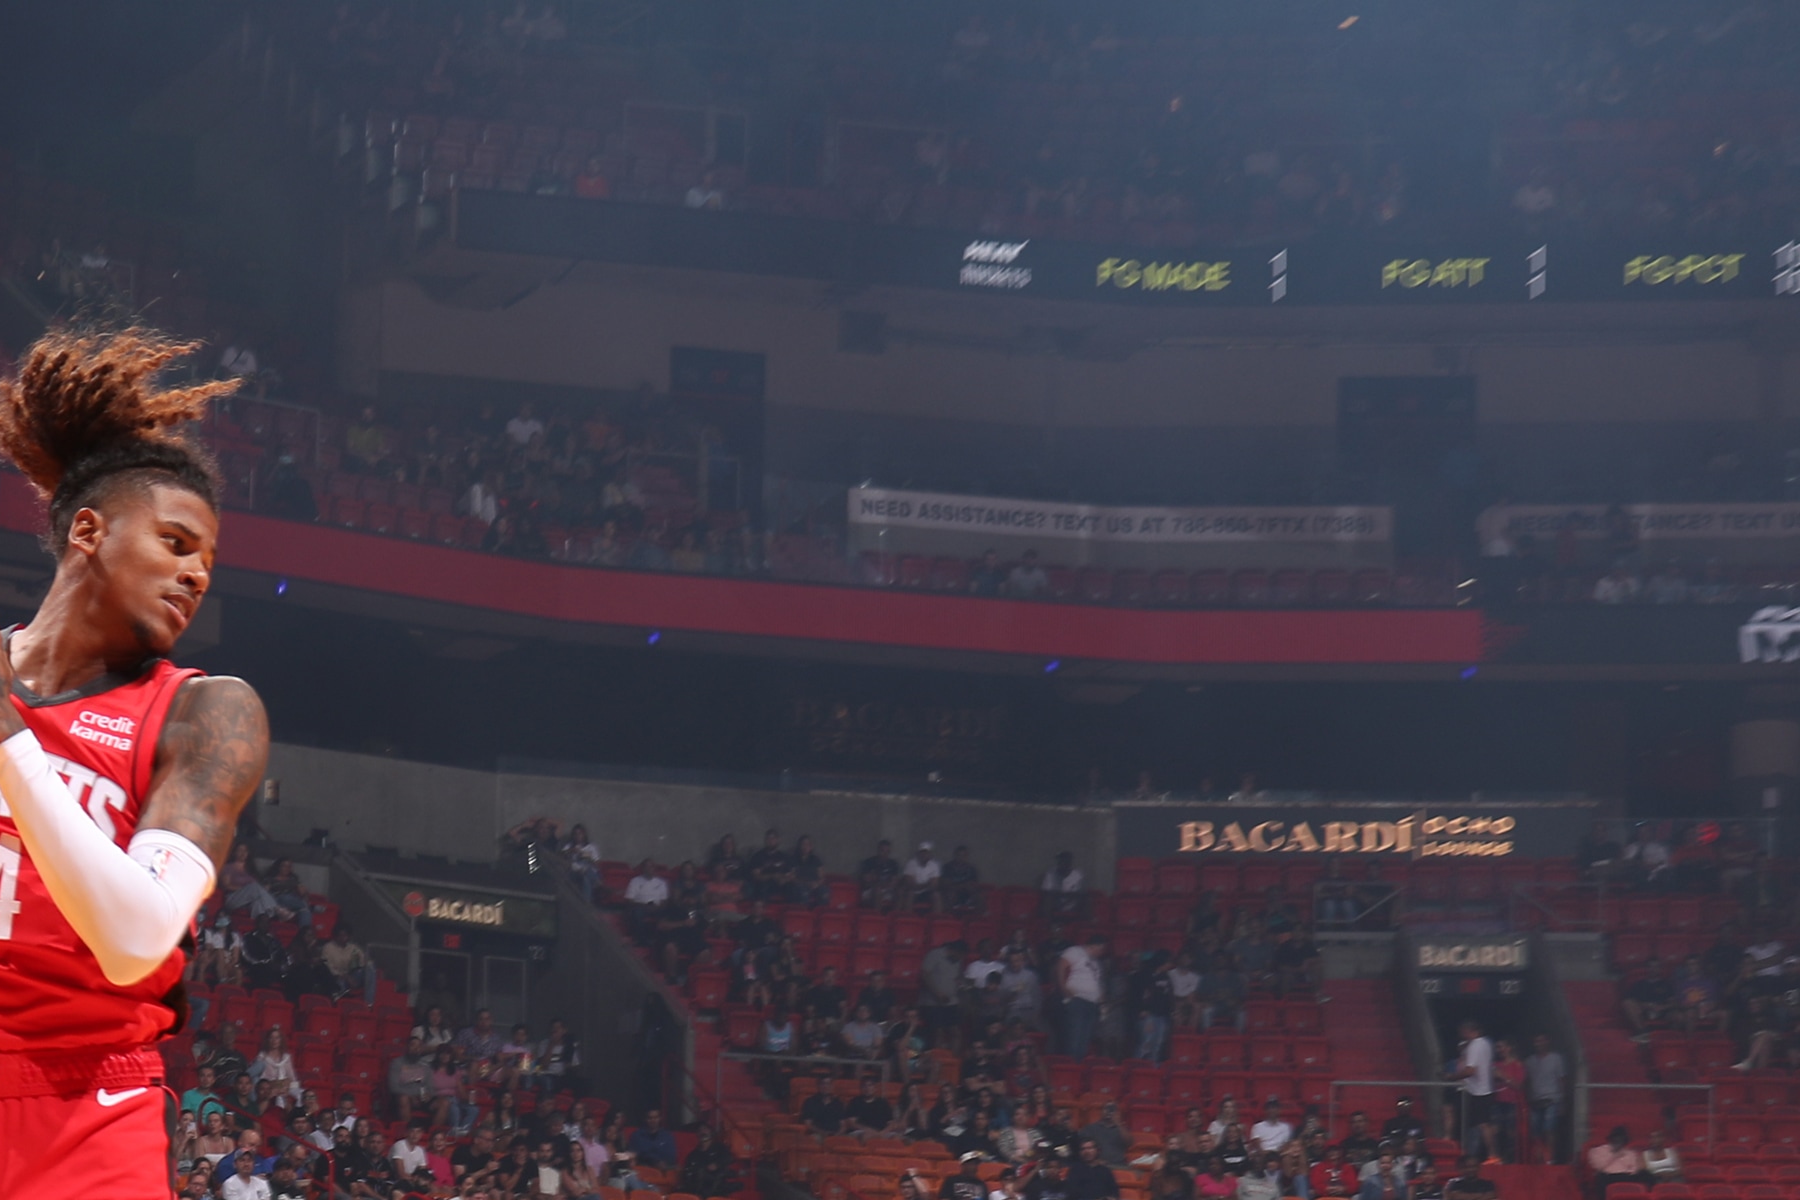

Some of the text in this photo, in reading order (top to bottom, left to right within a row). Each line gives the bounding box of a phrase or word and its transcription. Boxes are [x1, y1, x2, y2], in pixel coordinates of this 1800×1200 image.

[861, 498, 911, 519] NEED
[917, 502, 1047, 529] ASSISTANCE?
[1052, 511, 1101, 532] TEXT
[1107, 515, 1133, 533] US
[1139, 516, 1166, 533] AT
[1721, 512, 1769, 530] TEXT
[68, 720, 132, 752] karma
[78, 710, 136, 736] credit
[1177, 813, 1416, 853] BACARDÍ
[427, 897, 505, 926] BACARDÍ
[1419, 938, 1528, 968] BACARDÍ
